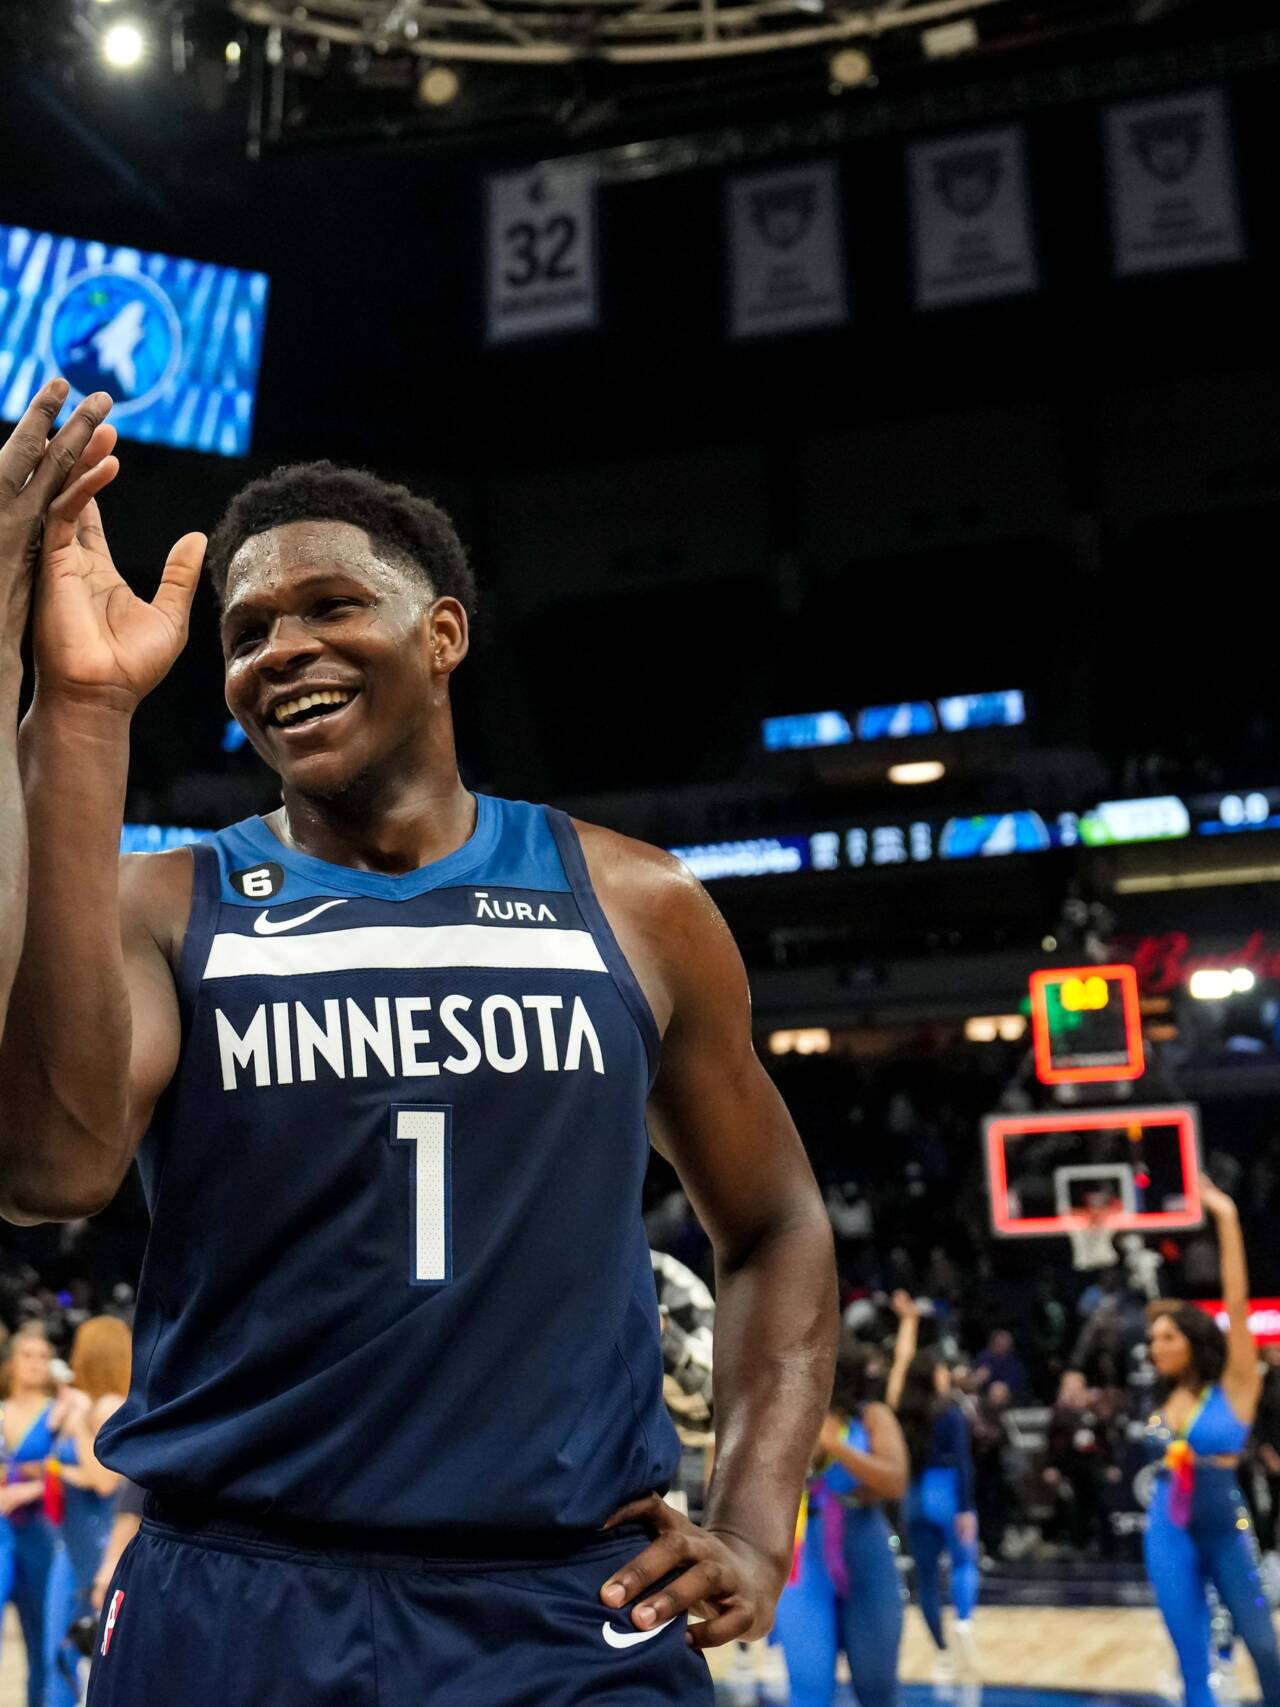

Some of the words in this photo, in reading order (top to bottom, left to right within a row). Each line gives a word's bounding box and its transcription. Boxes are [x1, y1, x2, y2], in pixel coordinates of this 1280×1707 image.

[505, 214, 577, 287] 32
[242, 868, 273, 898] 6
[215, 994, 605, 1091] MINNESOTA
[390, 1105, 451, 1284] 1
